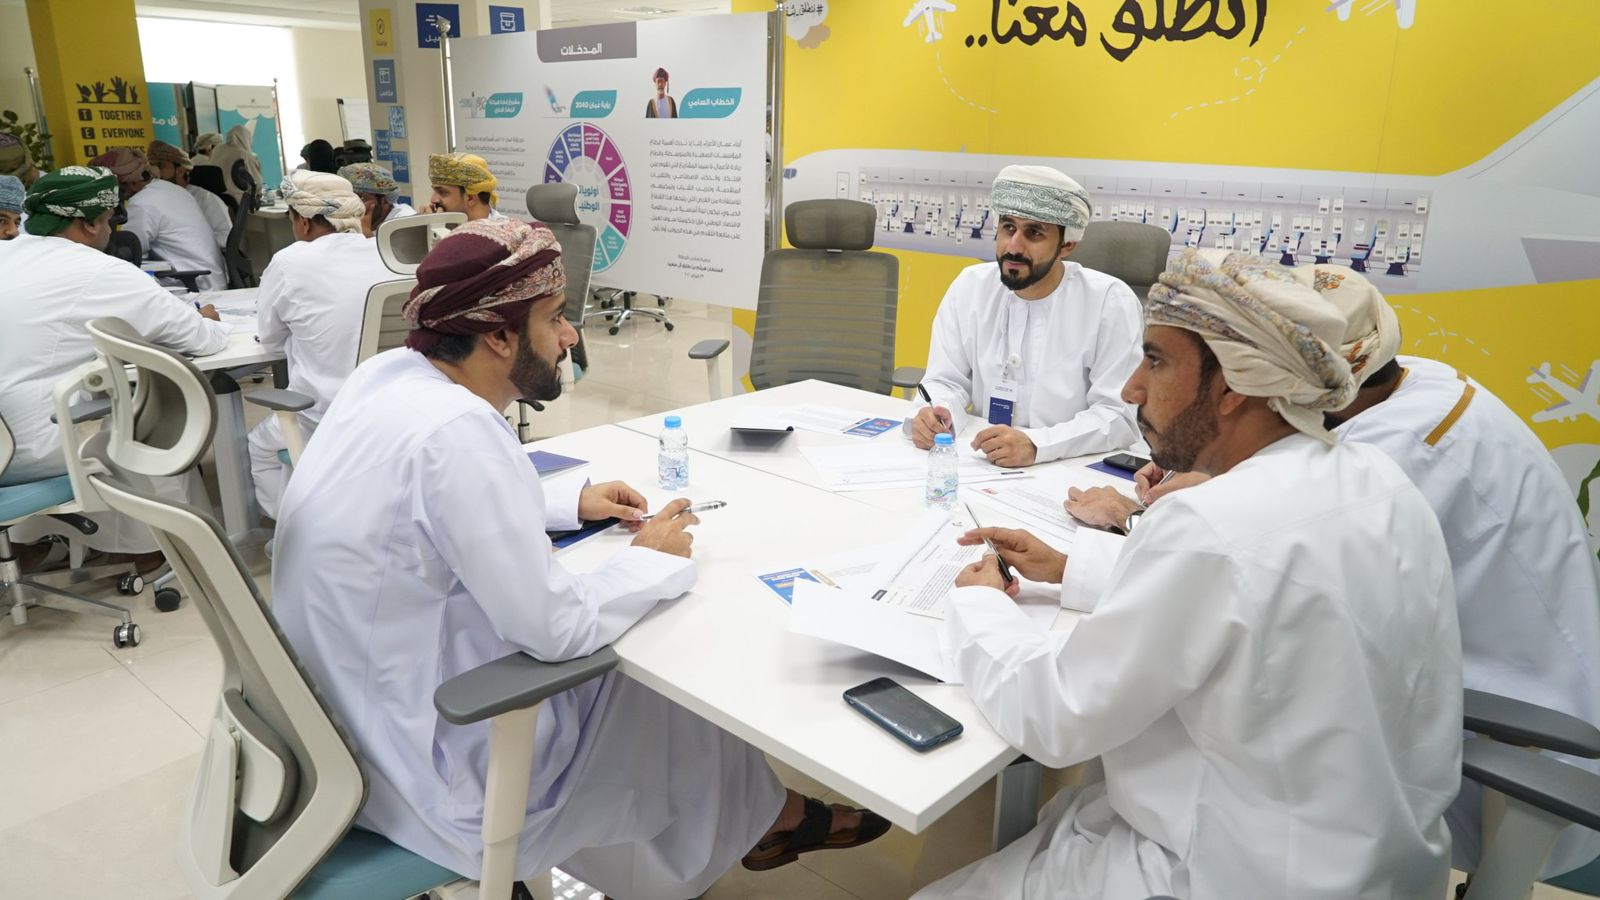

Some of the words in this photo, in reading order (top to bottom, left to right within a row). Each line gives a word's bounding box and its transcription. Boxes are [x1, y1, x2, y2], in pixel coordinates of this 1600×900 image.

[560, 43, 603, 56] المدخلات
[99, 110, 142, 121] TOGETHER
[102, 128, 145, 139] EVERYONE
[577, 200, 600, 213] الوطني
